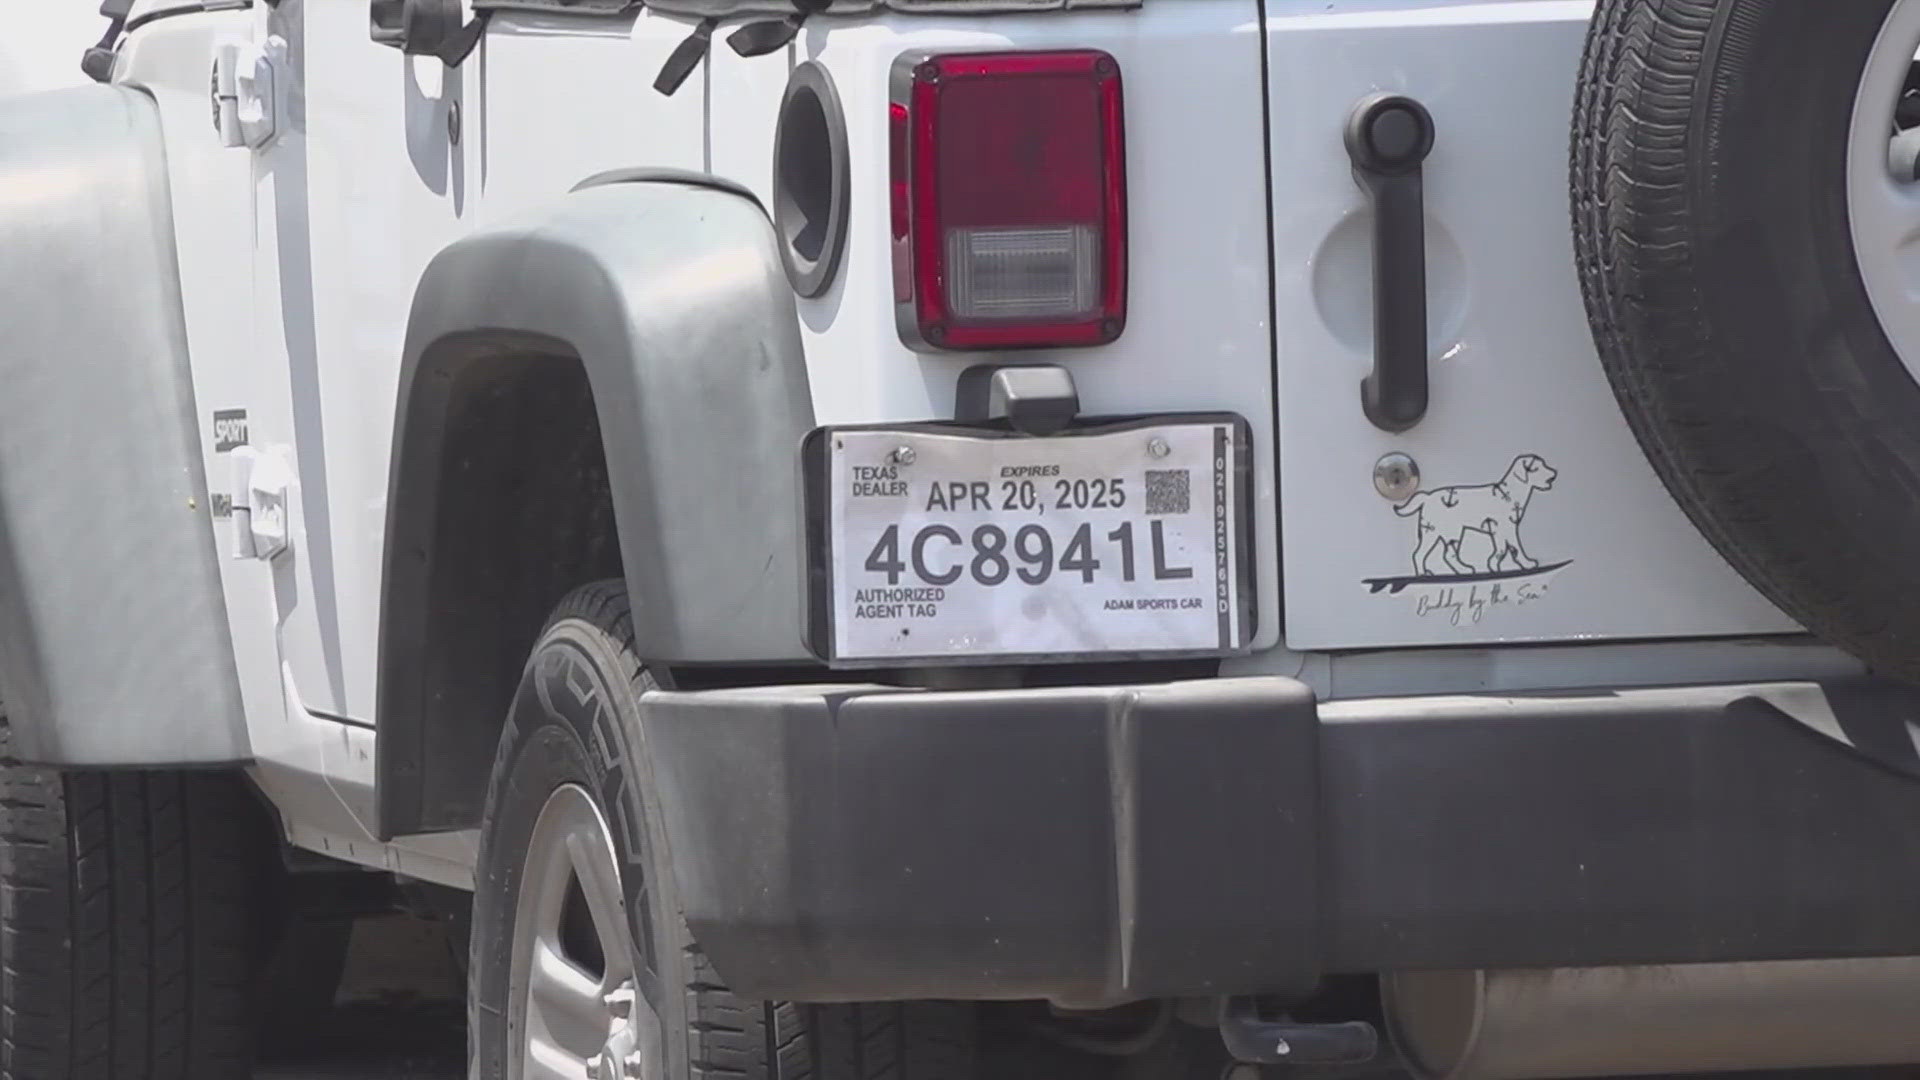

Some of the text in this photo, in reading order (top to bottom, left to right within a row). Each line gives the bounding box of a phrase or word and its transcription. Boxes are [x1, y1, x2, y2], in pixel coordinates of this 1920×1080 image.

[214, 419, 248, 443] SPORT
[852, 466, 898, 480] TEXAS
[1000, 465, 1060, 478] EXPIRES
[852, 481, 908, 497] DEALER
[926, 478, 1126, 515] APR 20, 2025
[865, 519, 1194, 586] 4C8941L
[854, 587, 946, 603] AUTHORIZED
[855, 603, 937, 618] AGENT TAG
[1103, 597, 1204, 610] ADAM SPORTS CAR
[1416, 587, 1463, 626] Buddy
[1468, 584, 1484, 624] by
[1490, 583, 1509, 605] the
